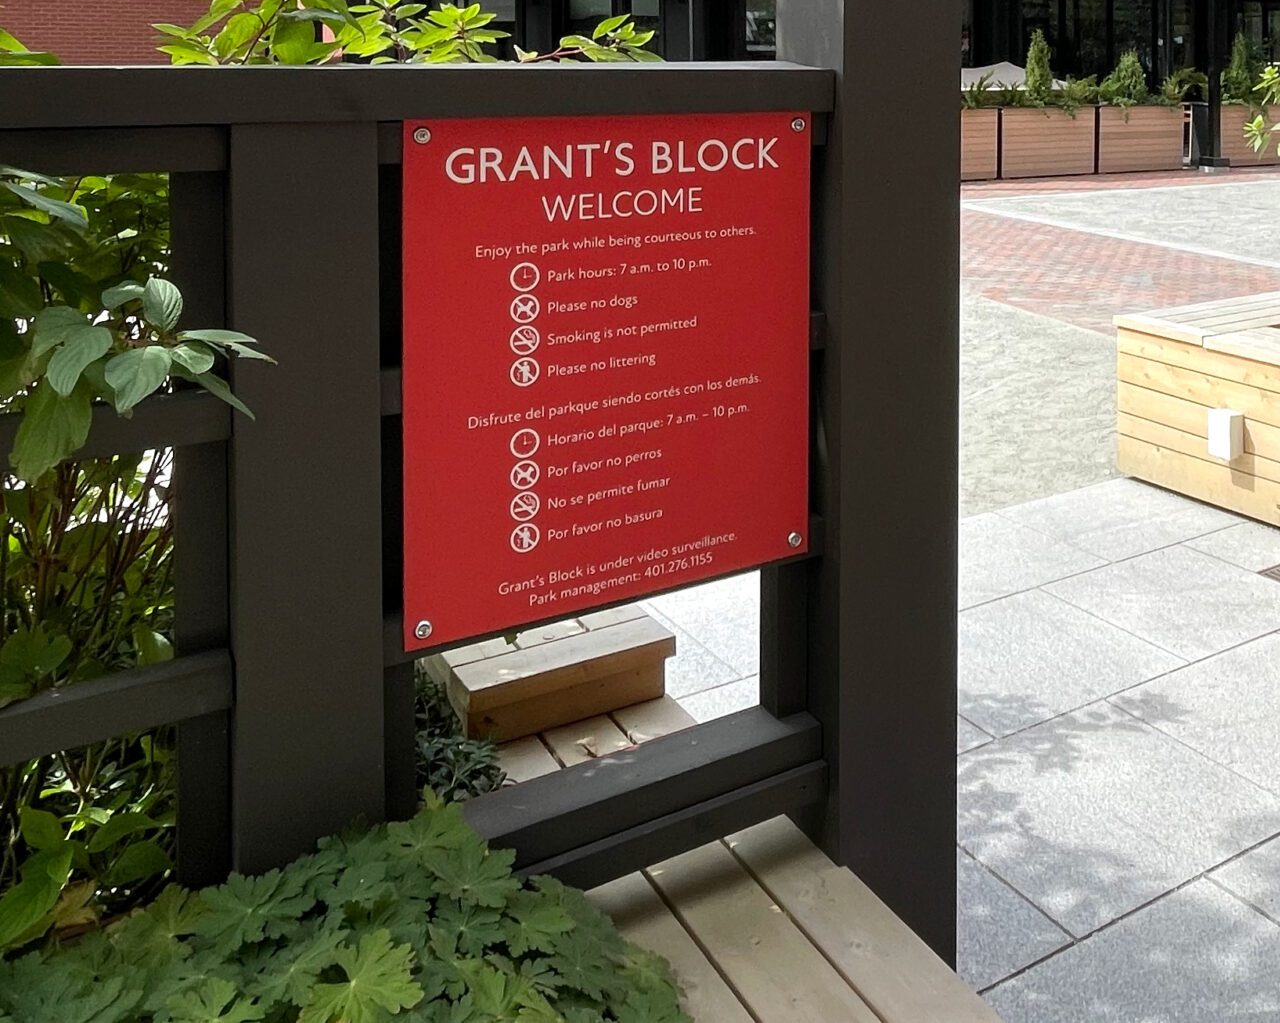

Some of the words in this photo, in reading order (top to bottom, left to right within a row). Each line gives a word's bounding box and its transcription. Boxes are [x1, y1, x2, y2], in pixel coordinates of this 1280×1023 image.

[445, 140, 634, 184] GRANT'S
[652, 138, 779, 174] BLOCK
[542, 187, 702, 222] WELCOME
[476, 245, 512, 260] Enjoy
[516, 242, 537, 254] the
[542, 238, 569, 254] park
[573, 236, 605, 249] while
[609, 235, 641, 248] being
[645, 231, 701, 243] courteous
[705, 231, 718, 239] to
[720, 226, 756, 237] others.
[548, 268, 575, 282] Park
[579, 268, 616, 279] hours:
[620, 263, 628, 274] 7
[630, 265, 653, 275] a.m.
[657, 263, 670, 272] to
[673, 258, 686, 269] 10
[689, 259, 711, 271] p.m.
[548, 301, 587, 314] Please
[591, 300, 606, 309] no
[610, 295, 638, 308] dogs
[547, 330, 600, 345] Smoking
[604, 328, 614, 339] is
[617, 326, 637, 337] not
[641, 316, 696, 336] permitted
[548, 364, 586, 377] Please
[591, 362, 606, 372] no
[610, 353, 656, 368] littering
[468, 413, 521, 429] Disfrute
[525, 406, 544, 419] del
[549, 401, 598, 419] parkque
[602, 392, 641, 407] siendo
[645, 386, 680, 400] cortés
[684, 384, 703, 395] con
[707, 380, 722, 391] los
[725, 374, 762, 387] demás.
[548, 431, 594, 446] Horario
[598, 424, 616, 437] del
[620, 420, 663, 436] parque:
[667, 414, 674, 425] 7
[676, 414, 698, 425] a.m.
[713, 405, 725, 417] 10
[728, 405, 750, 417] p.m.
[548, 466, 568, 478] Por
[572, 460, 603, 473] favor
[607, 457, 622, 468] no
[626, 450, 662, 467] perros
[548, 497, 566, 509] No
[571, 495, 584, 506] se
[588, 485, 633, 504] permite
[637, 478, 670, 491] fumar
[548, 529, 568, 541] Por
[572, 522, 603, 536] favor
[607, 519, 622, 529] no
[625, 510, 662, 524] basura
[499, 575, 544, 595] Grant's
[549, 566, 583, 583] Block
[587, 565, 596, 576] is
[599, 556, 634, 572] under
[637, 548, 668, 562] video
[672, 533, 737, 555] surveillance.
[530, 590, 557, 606] Park
[560, 572, 641, 599] management:
[644, 552, 713, 578] 401.276.1155
